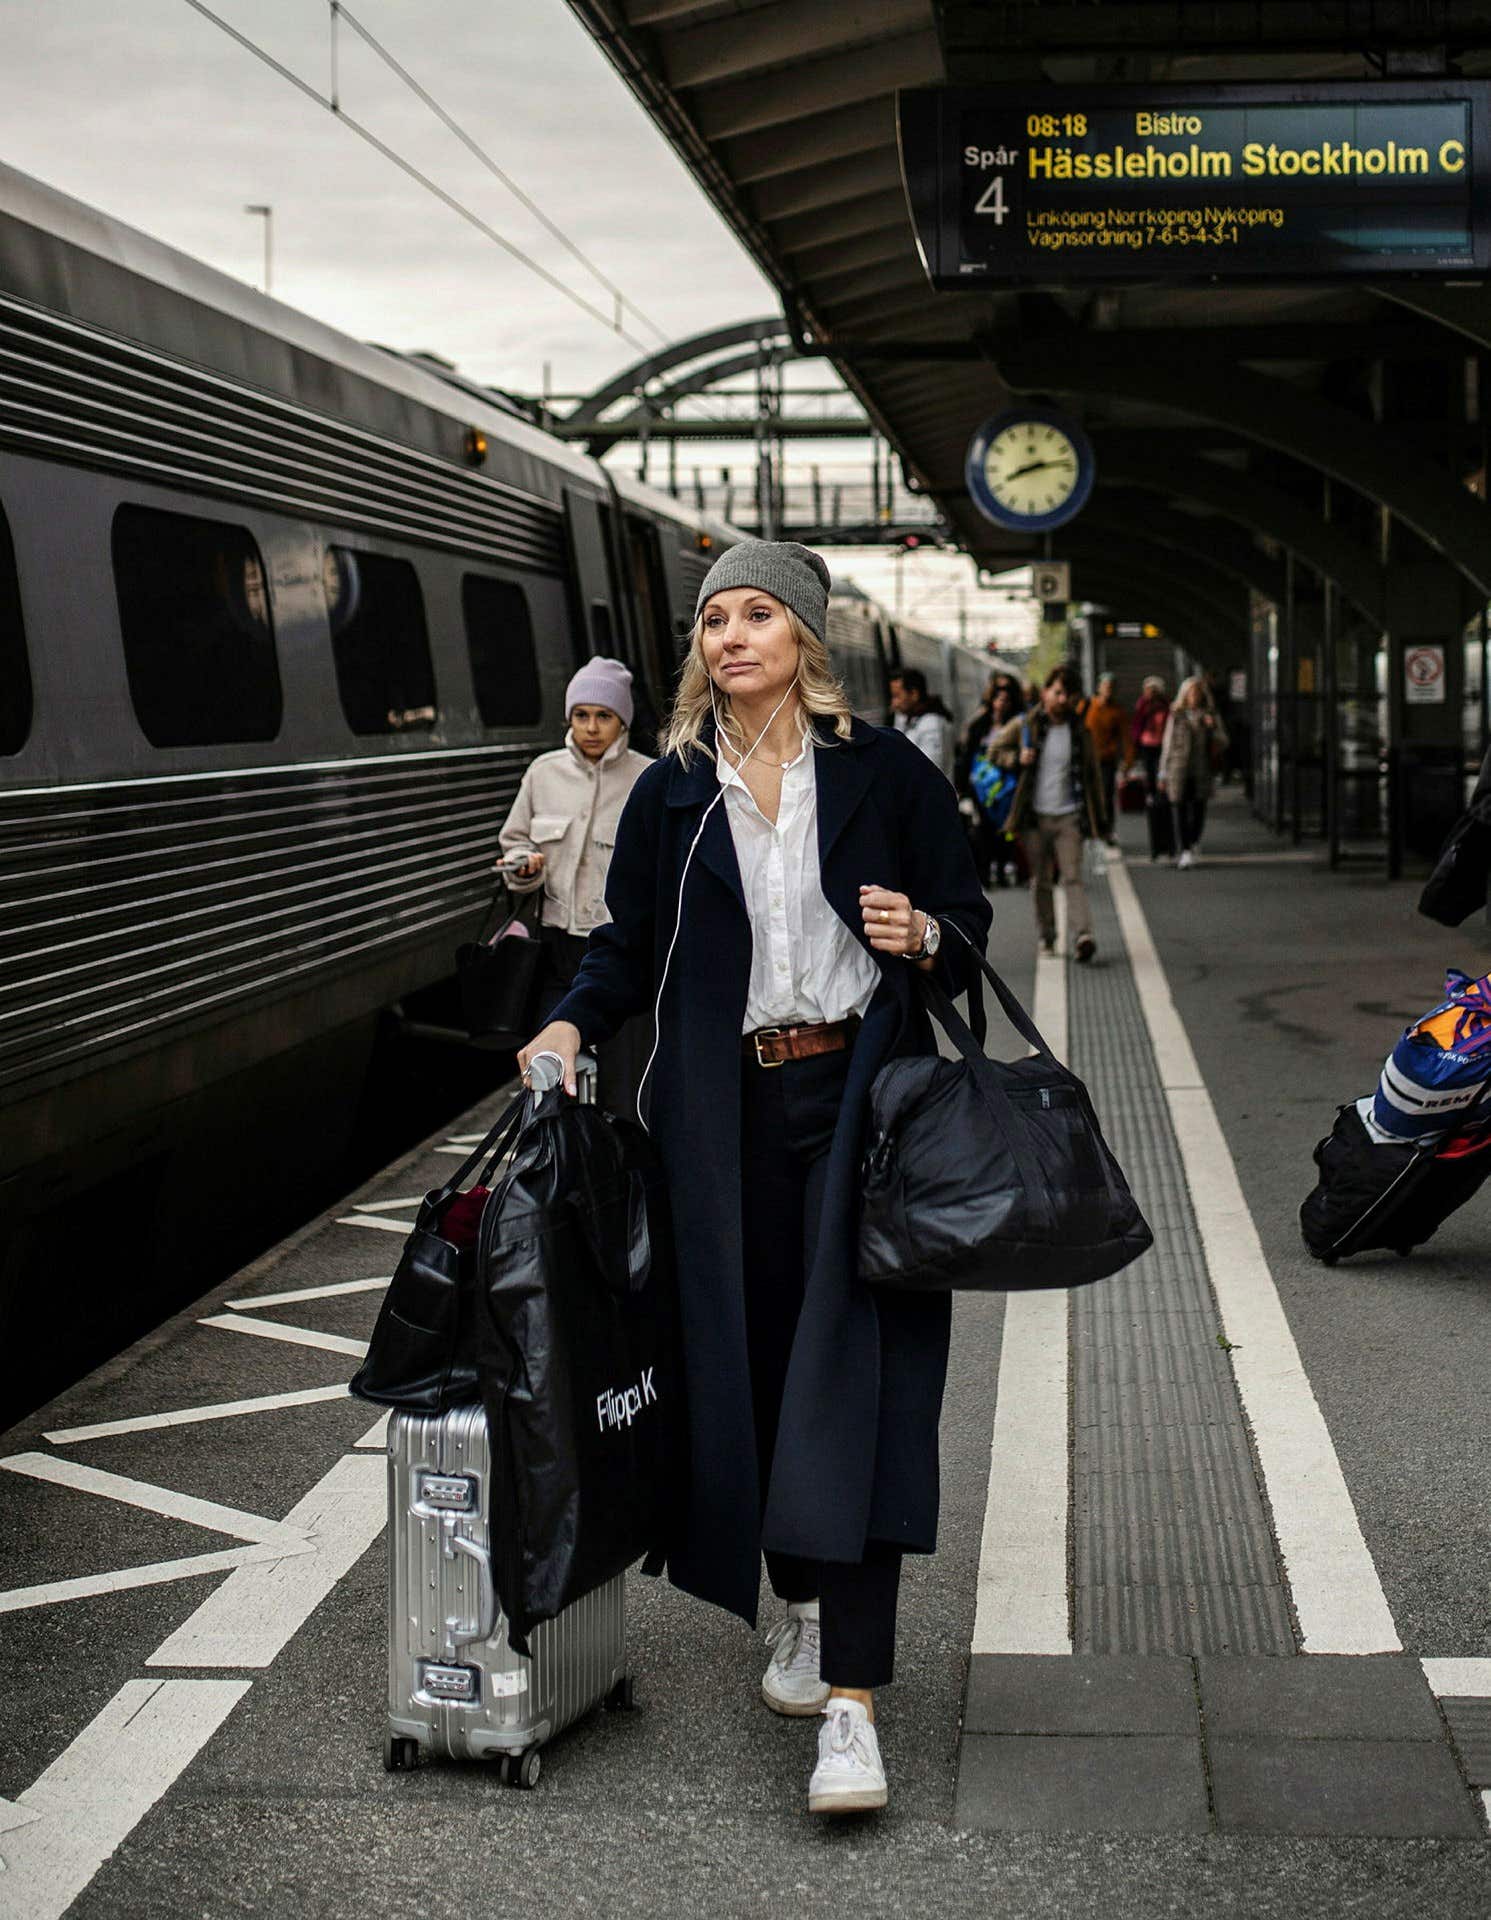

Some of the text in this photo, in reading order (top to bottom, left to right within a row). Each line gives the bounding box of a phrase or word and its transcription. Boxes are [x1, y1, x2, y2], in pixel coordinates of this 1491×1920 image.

[1026, 112, 1202, 137] 08:18 Bistro
[964, 145, 1019, 170] Spår
[1028, 140, 1465, 178] Hässleholm Stockholm C
[974, 176, 1010, 225] 4
[596, 1366, 657, 1433] Filippa K
